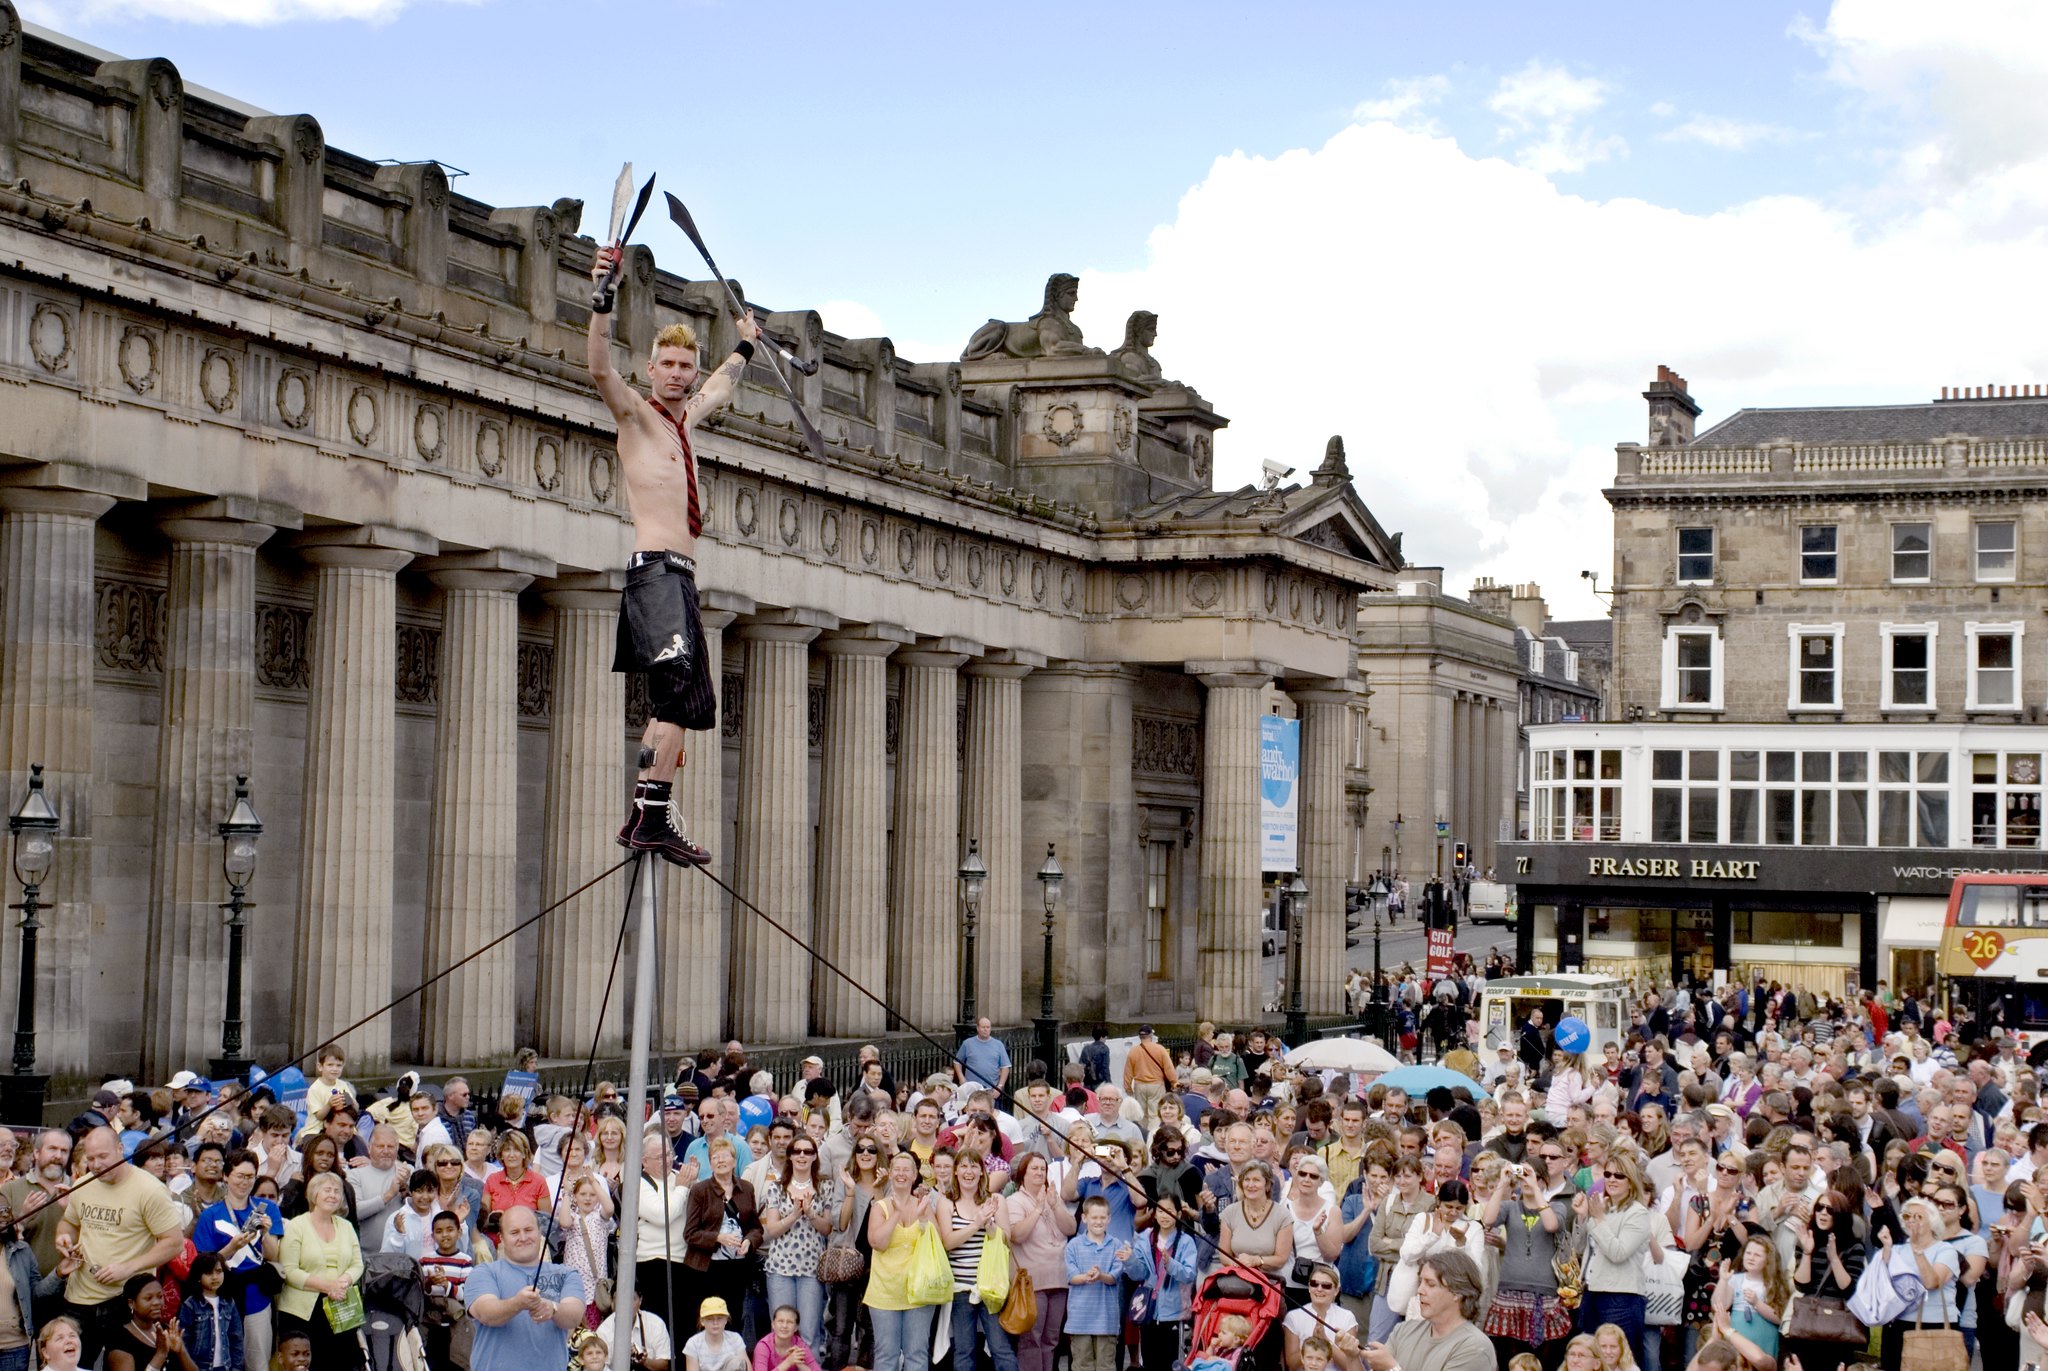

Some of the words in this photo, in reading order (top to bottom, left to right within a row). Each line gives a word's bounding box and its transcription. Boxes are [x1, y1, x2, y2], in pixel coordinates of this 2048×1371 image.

[1262, 745, 1283, 764] andy
[1262, 760, 1295, 782] warhol
[1516, 857, 1528, 874] 77
[1588, 857, 1680, 877] FRASER
[1690, 859, 1761, 879] HART
[1431, 930, 1452, 945] CITY
[1970, 935, 1998, 959] 26
[1429, 944, 1453, 958] GOLF
[80, 1202, 124, 1226] DOCKERS
